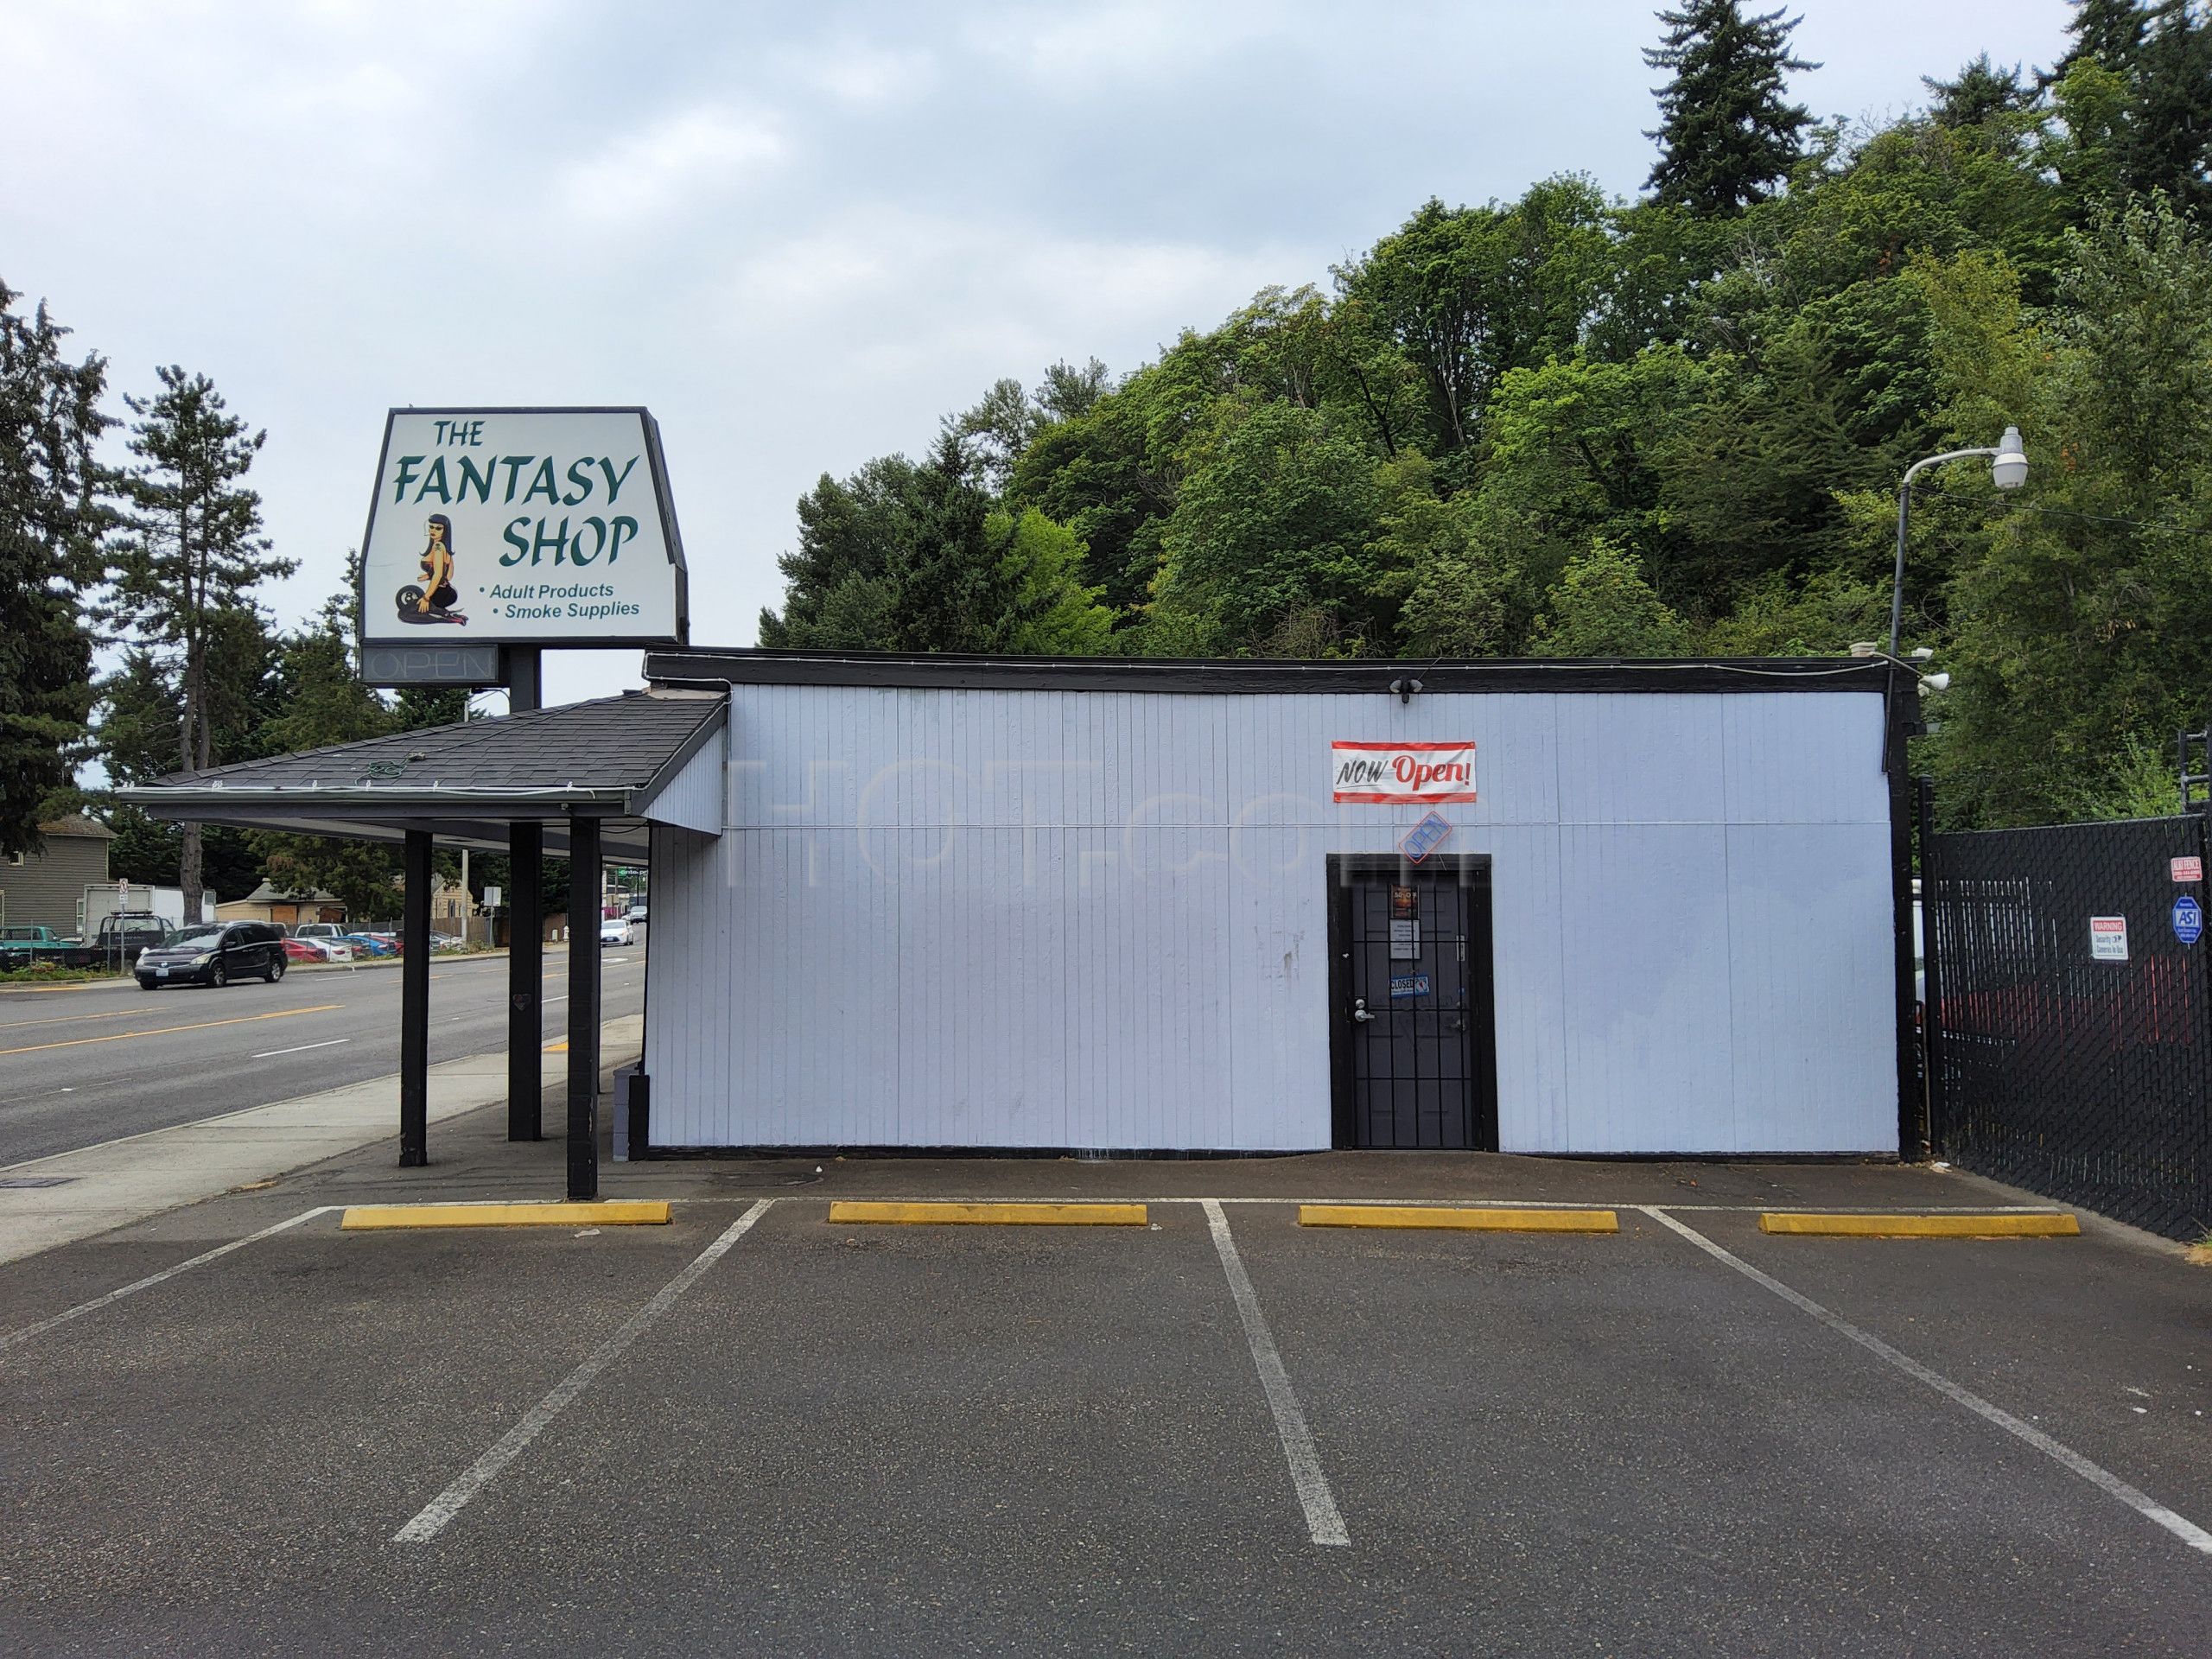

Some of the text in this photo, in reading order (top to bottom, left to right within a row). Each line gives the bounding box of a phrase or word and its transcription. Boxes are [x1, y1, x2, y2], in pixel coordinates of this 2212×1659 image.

[433, 420, 486, 447] THE
[392, 454, 640, 506] FANTASY
[499, 516, 639, 568] SHOP
[489, 583, 614, 599] Adult Products
[505, 601, 640, 620] Smoke Supplies
[372, 651, 493, 679] OPEN
[1336, 755, 1471, 791] NOW Open!
[1404, 818, 1449, 858] OPEN
[2094, 921, 2123, 931] WARNING
[2178, 911, 2196, 925] ASI
